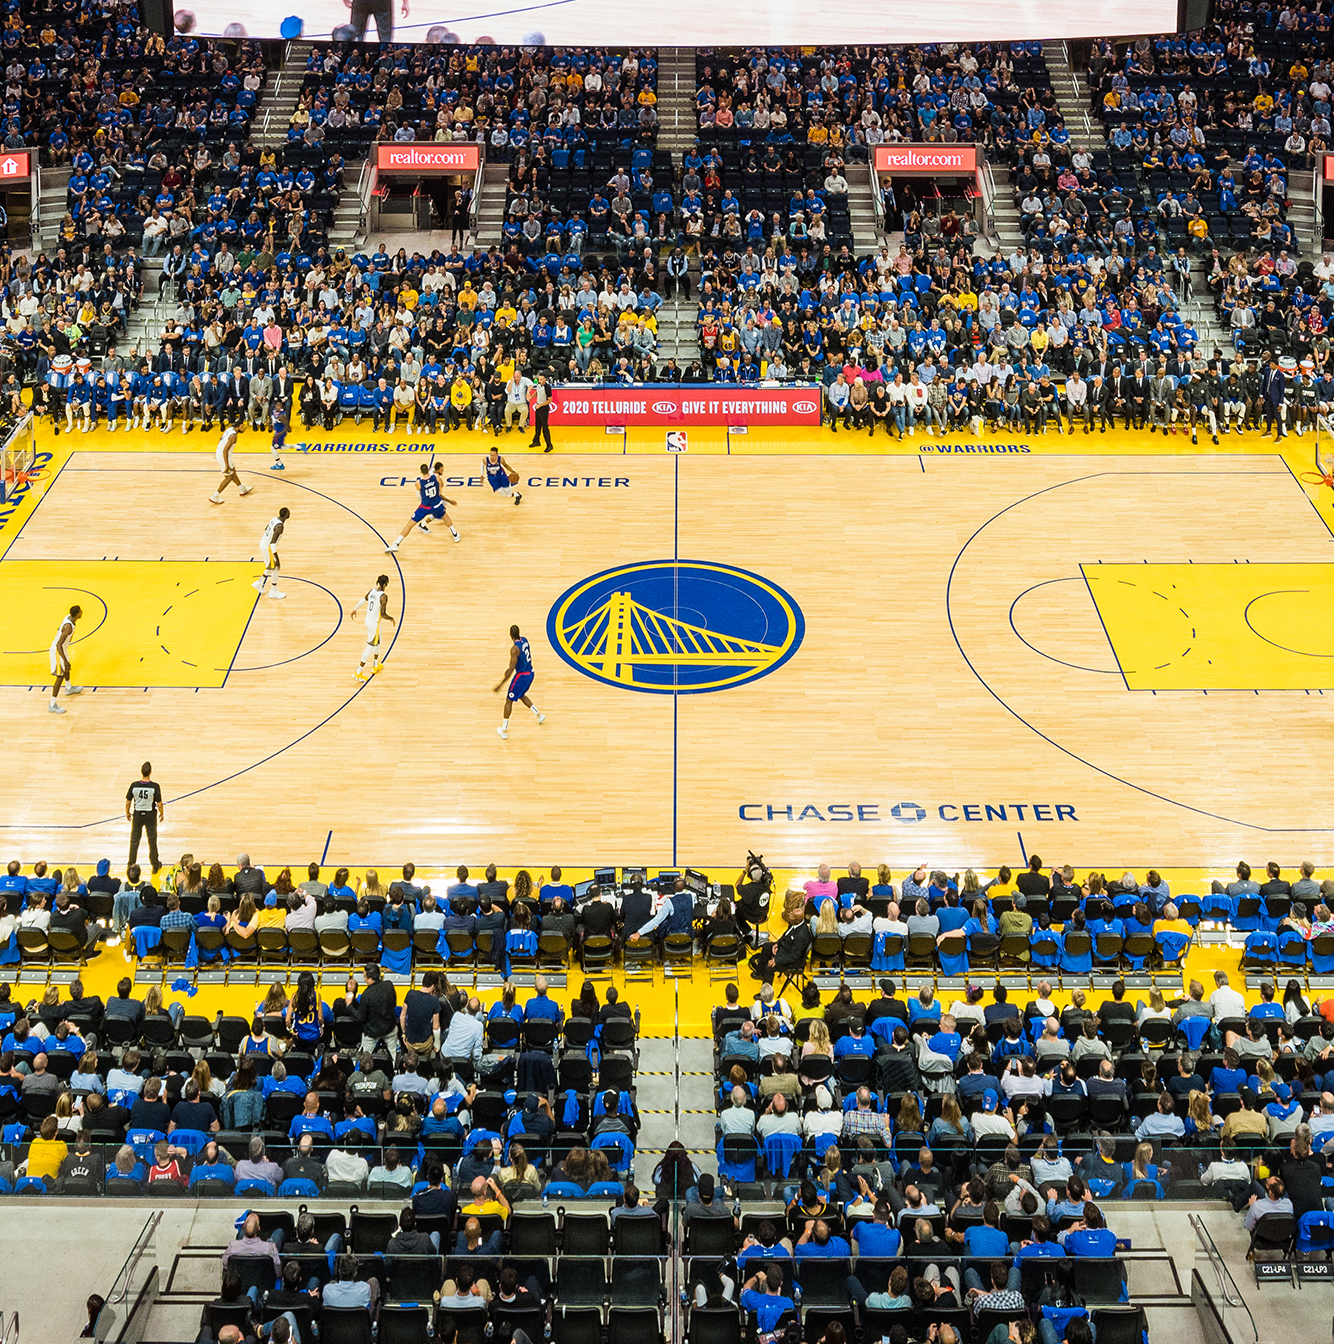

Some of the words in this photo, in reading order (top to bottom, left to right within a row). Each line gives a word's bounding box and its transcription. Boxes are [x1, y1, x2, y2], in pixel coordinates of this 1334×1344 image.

[388, 149, 463, 166] realtor.com
[887, 150, 963, 167] realtor.com
[563, 400, 590, 414] 2020
[592, 400, 647, 414] TELLURIDE
[656, 402, 673, 412] KIA
[682, 400, 704, 414] GIVE
[705, 400, 718, 414] IT
[721, 400, 787, 414] EVERYTHING
[919, 444, 1031, 454] @WARRIORS
[527, 476, 631, 488] CENTER
[138, 789, 149, 799] 45
[739, 803, 881, 823] CHASE
[938, 803, 1080, 823] CENTER
